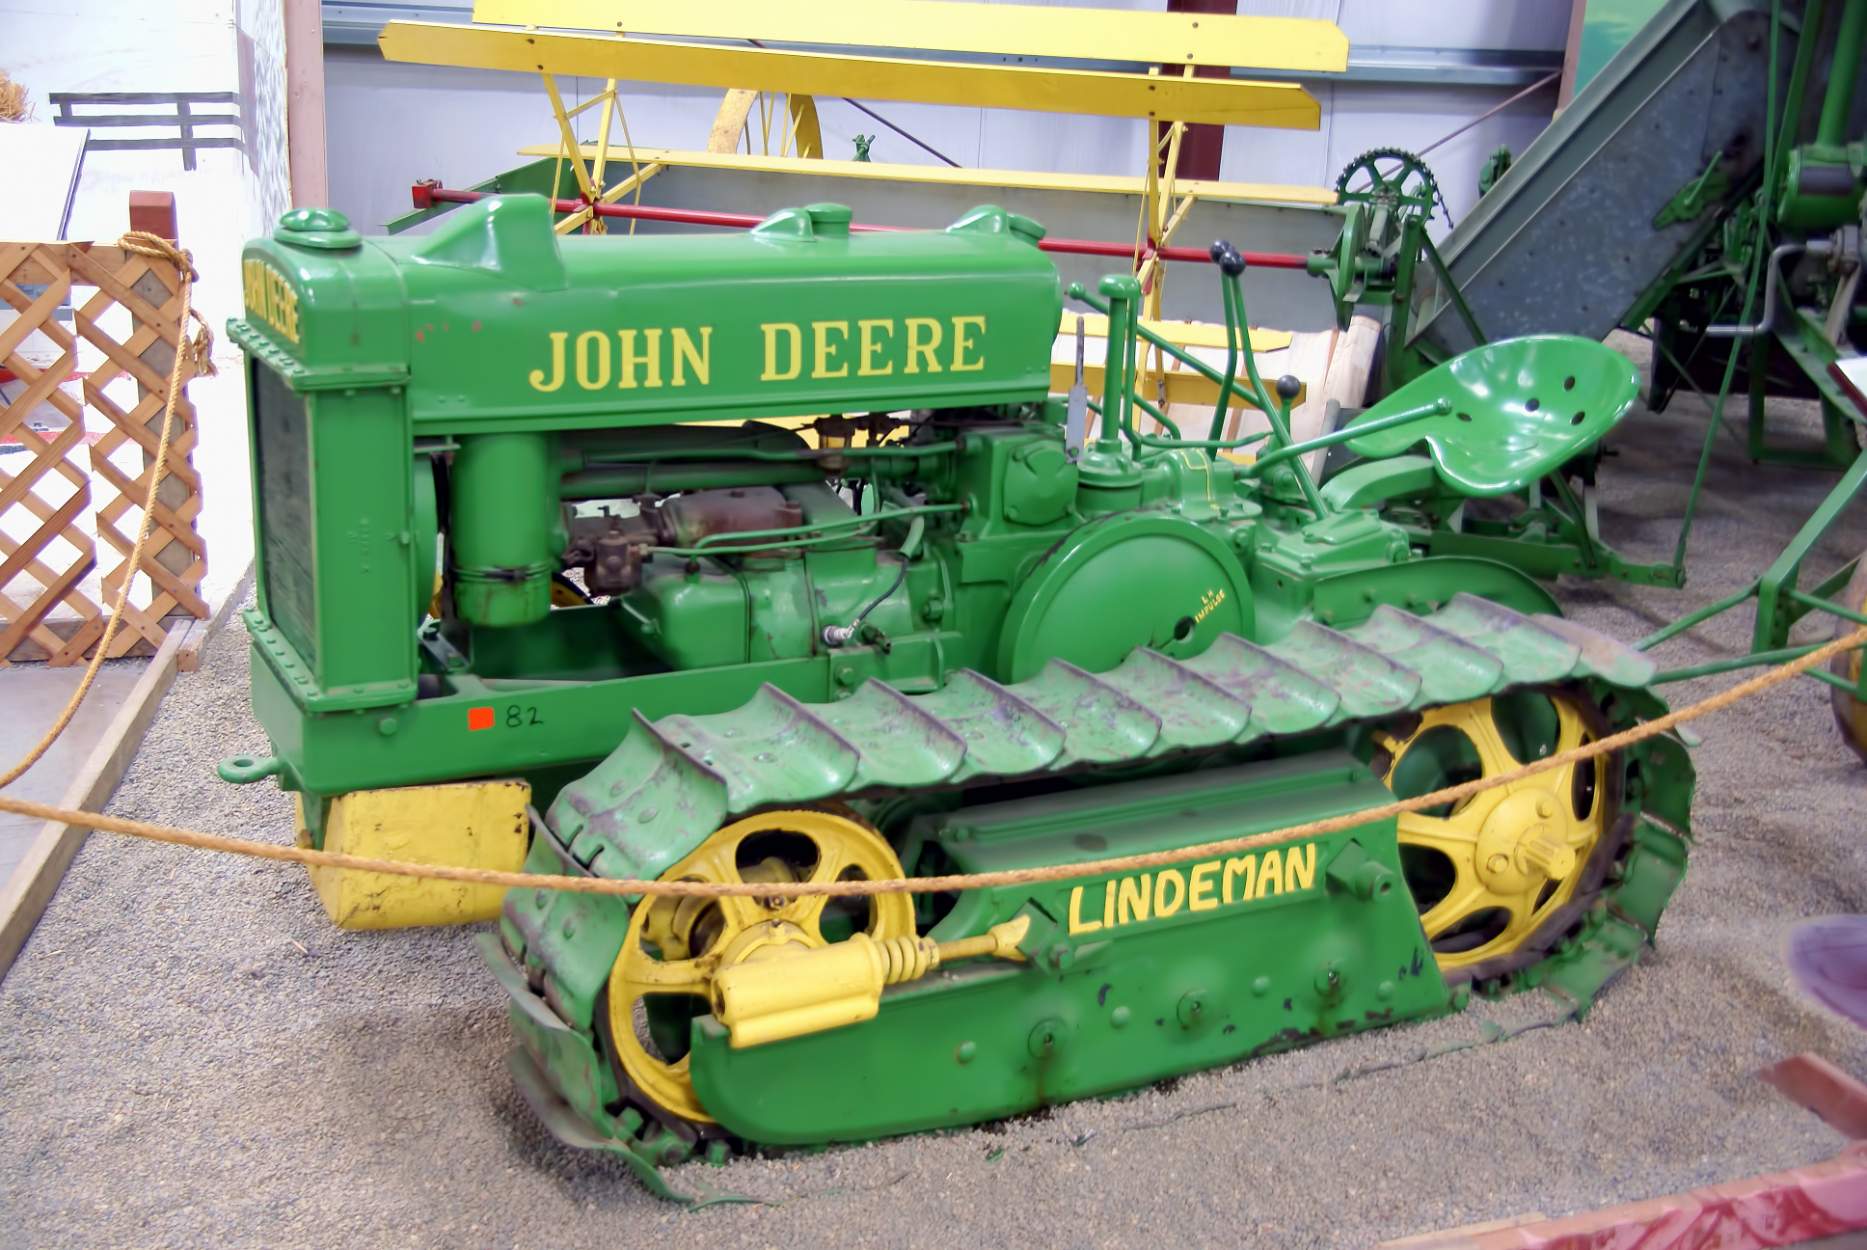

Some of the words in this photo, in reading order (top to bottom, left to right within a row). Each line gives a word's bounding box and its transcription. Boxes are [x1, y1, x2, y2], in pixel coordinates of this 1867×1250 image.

[529, 327, 712, 392] JOHN
[760, 316, 987, 381] DEERE
[506, 704, 544, 728] 82
[1068, 843, 1316, 936] LINDEMAN
